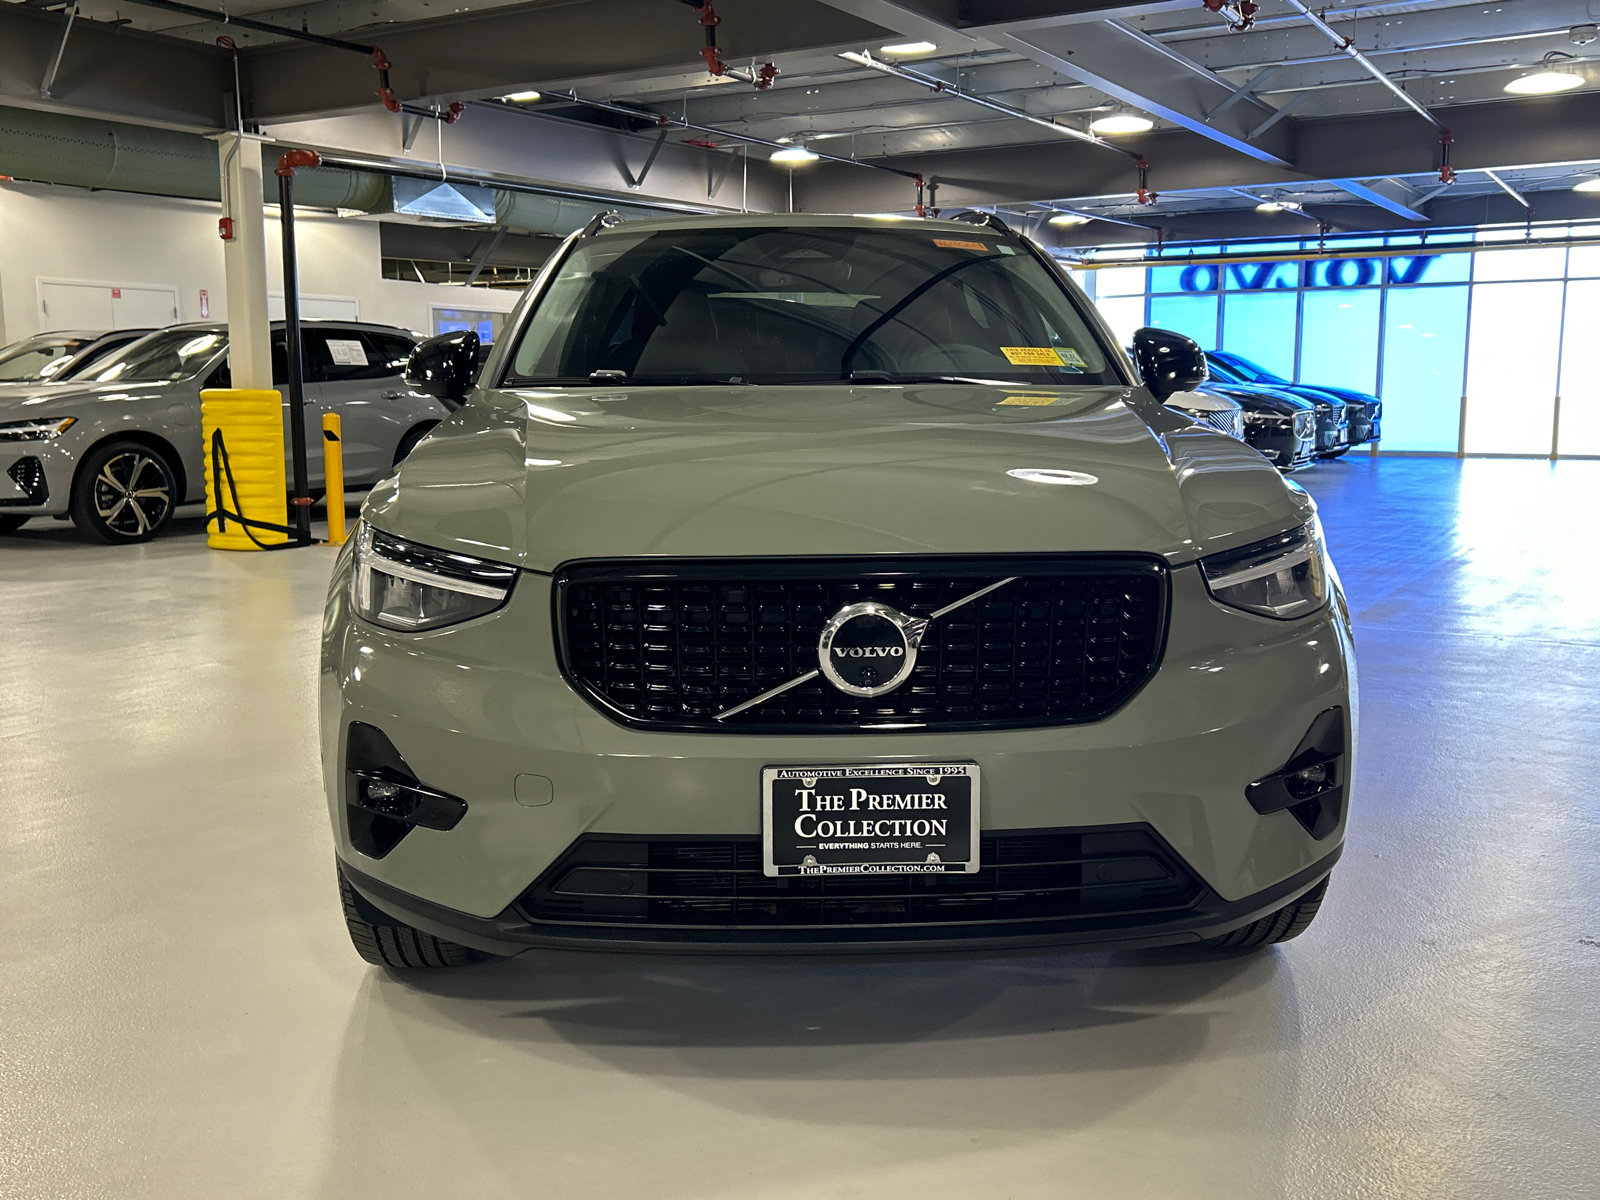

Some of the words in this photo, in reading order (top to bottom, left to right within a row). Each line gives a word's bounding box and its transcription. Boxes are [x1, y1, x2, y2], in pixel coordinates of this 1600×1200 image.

[832, 646, 904, 658] VOLVO
[939, 767, 965, 775] 1995
[794, 788, 846, 812] THE
[848, 788, 948, 811] PREMIER
[794, 813, 948, 838] COLLECTION
[818, 842, 869, 850] EVERYTHING
[900, 841, 923, 849] HERE.
